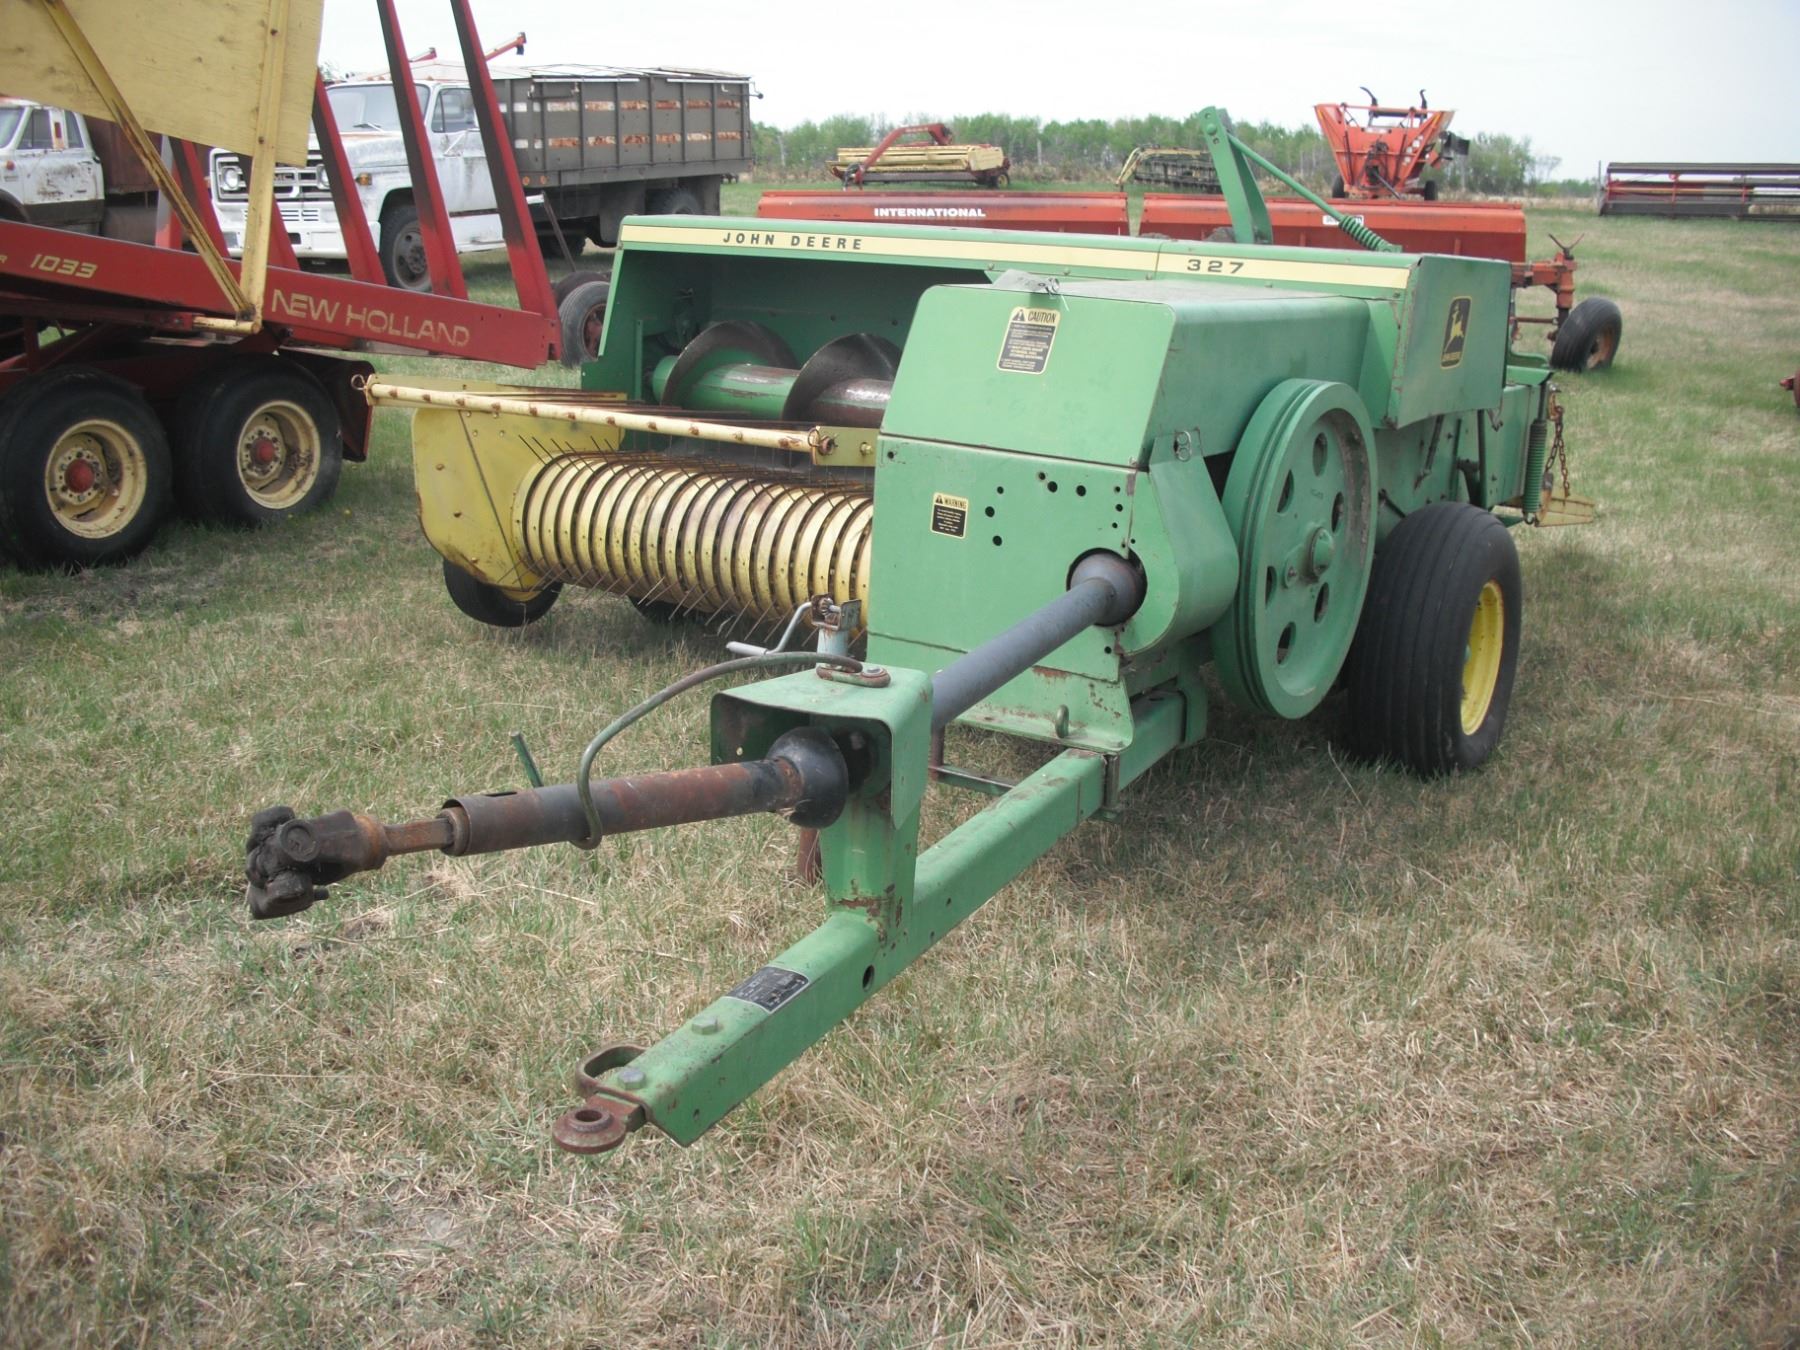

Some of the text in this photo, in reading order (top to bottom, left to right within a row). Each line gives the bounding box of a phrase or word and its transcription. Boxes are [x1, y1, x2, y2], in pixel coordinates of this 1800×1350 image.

[874, 208, 987, 217] INTERNATIONAL
[723, 232, 862, 250] JOHN DEERE
[30, 254, 98, 278] 1033
[1187, 259, 1244, 274] 327
[271, 289, 470, 347] NEW HOLLAND
[1027, 310, 1057, 323] CAUTION
[943, 498, 967, 509] WARNING
